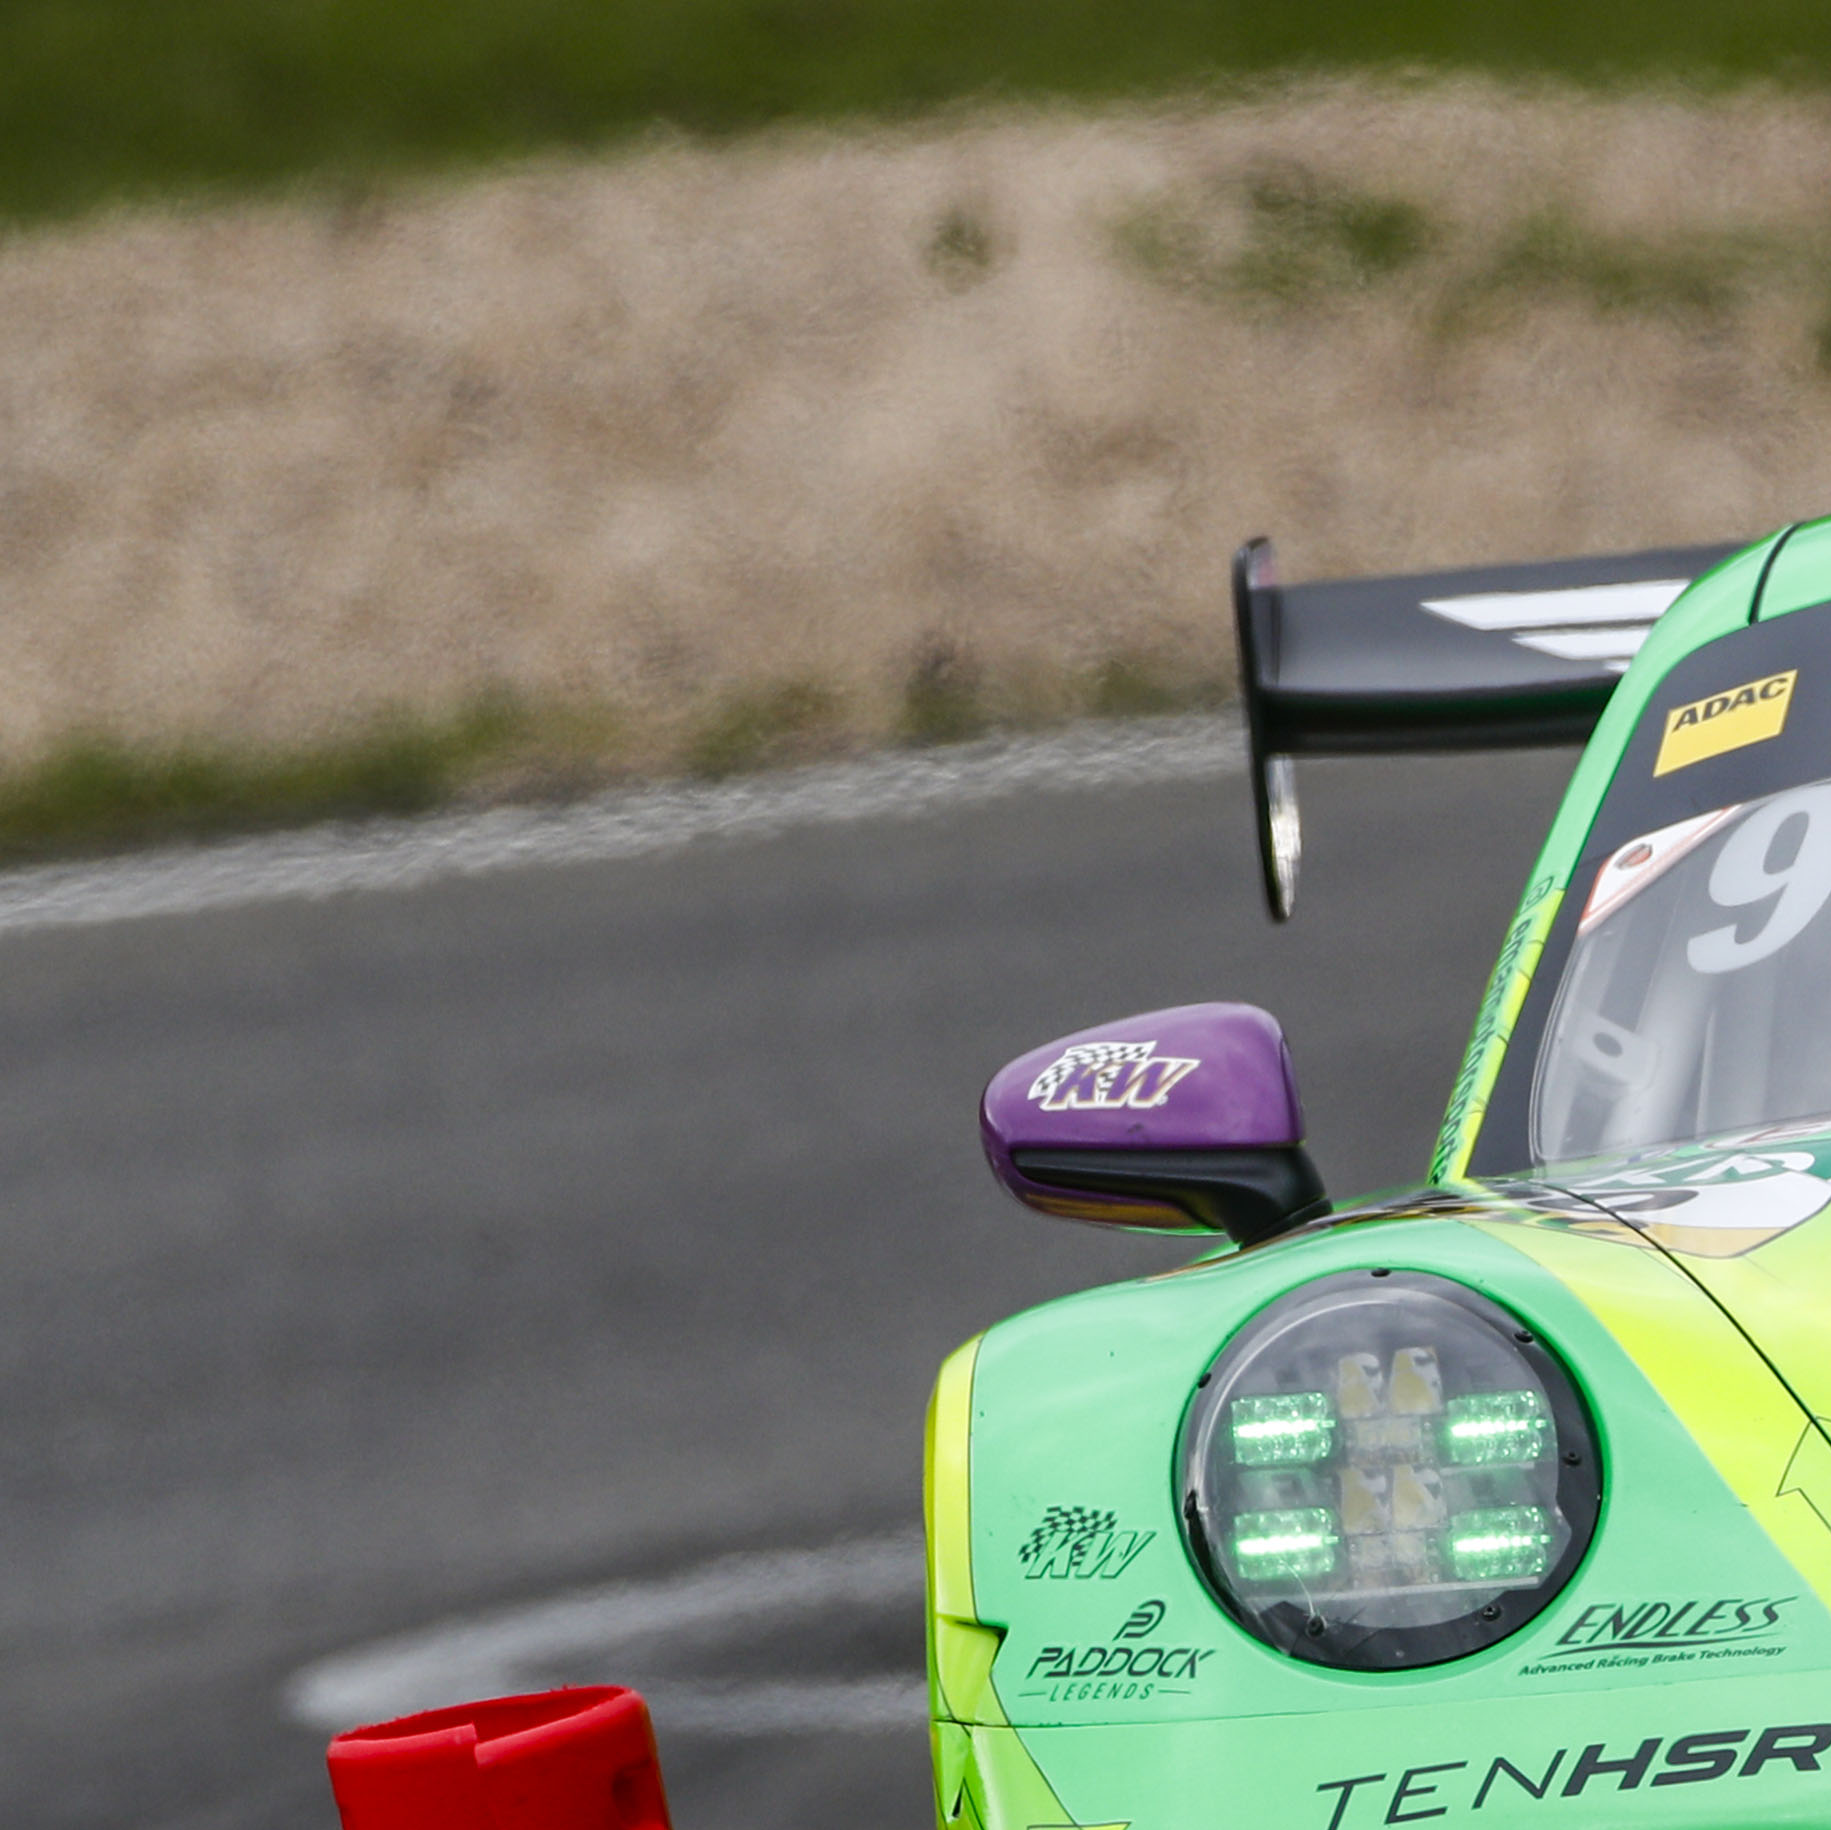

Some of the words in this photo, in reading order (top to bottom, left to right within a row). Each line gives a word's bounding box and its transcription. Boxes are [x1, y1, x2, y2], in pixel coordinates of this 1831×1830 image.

[1671, 676, 1789, 734] ADAC
[1555, 1595, 1799, 1646] ENDLESS
[1025, 1647, 1217, 1680] PADDOCK
[1518, 1658, 1595, 1677] Advanced
[1597, 1654, 1649, 1671] Racing
[1652, 1650, 1697, 1664] Brake
[1698, 1644, 1787, 1661] Technology
[1049, 1682, 1156, 1703] LEGENDS
